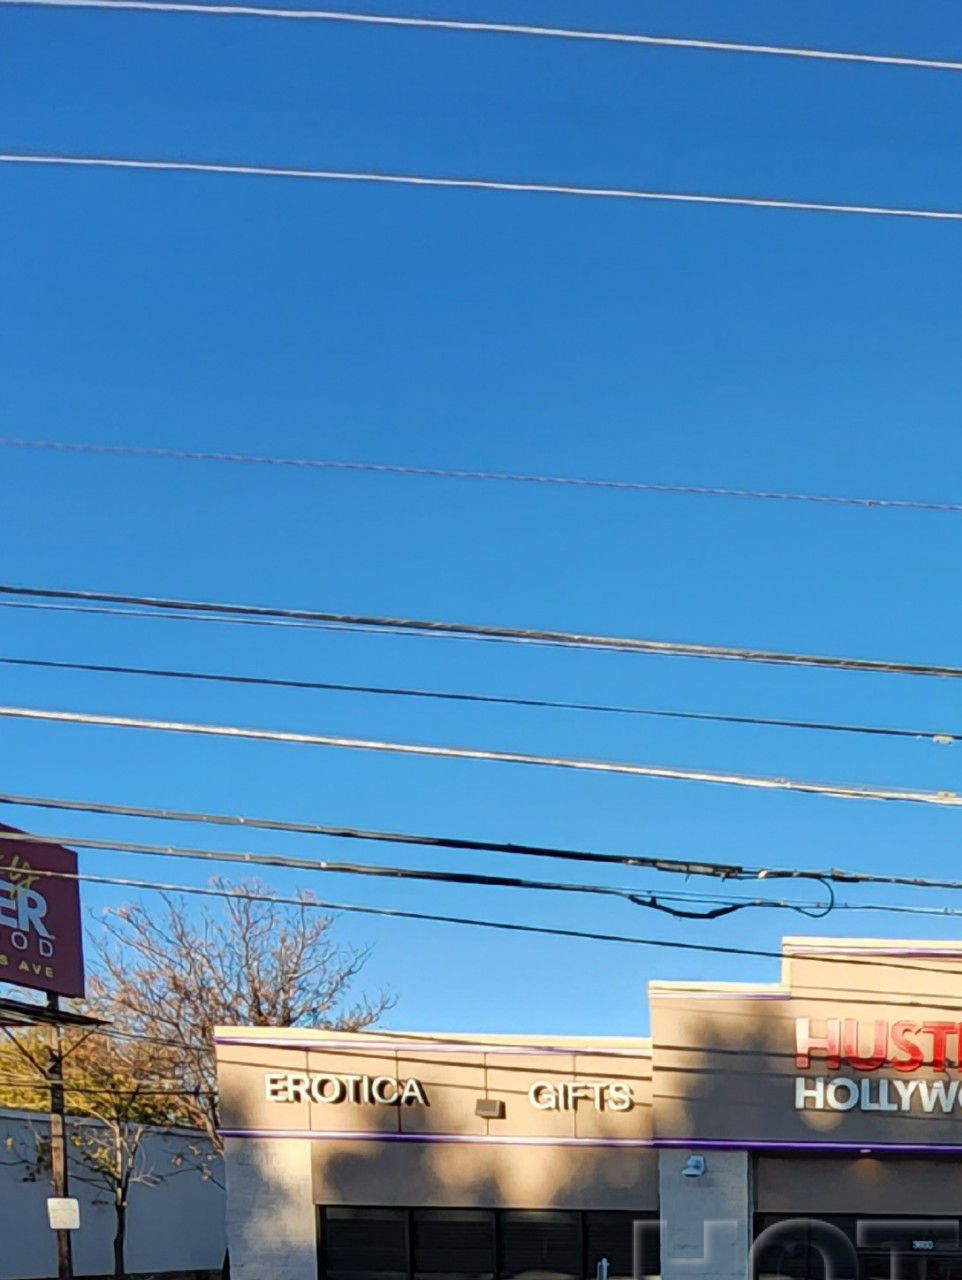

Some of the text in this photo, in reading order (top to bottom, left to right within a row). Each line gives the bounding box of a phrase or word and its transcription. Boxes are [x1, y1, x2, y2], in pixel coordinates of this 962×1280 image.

[19, 960, 54, 978] AVE
[264, 1073, 427, 1106] EROTICA
[527, 1081, 634, 1112] GIFTS
